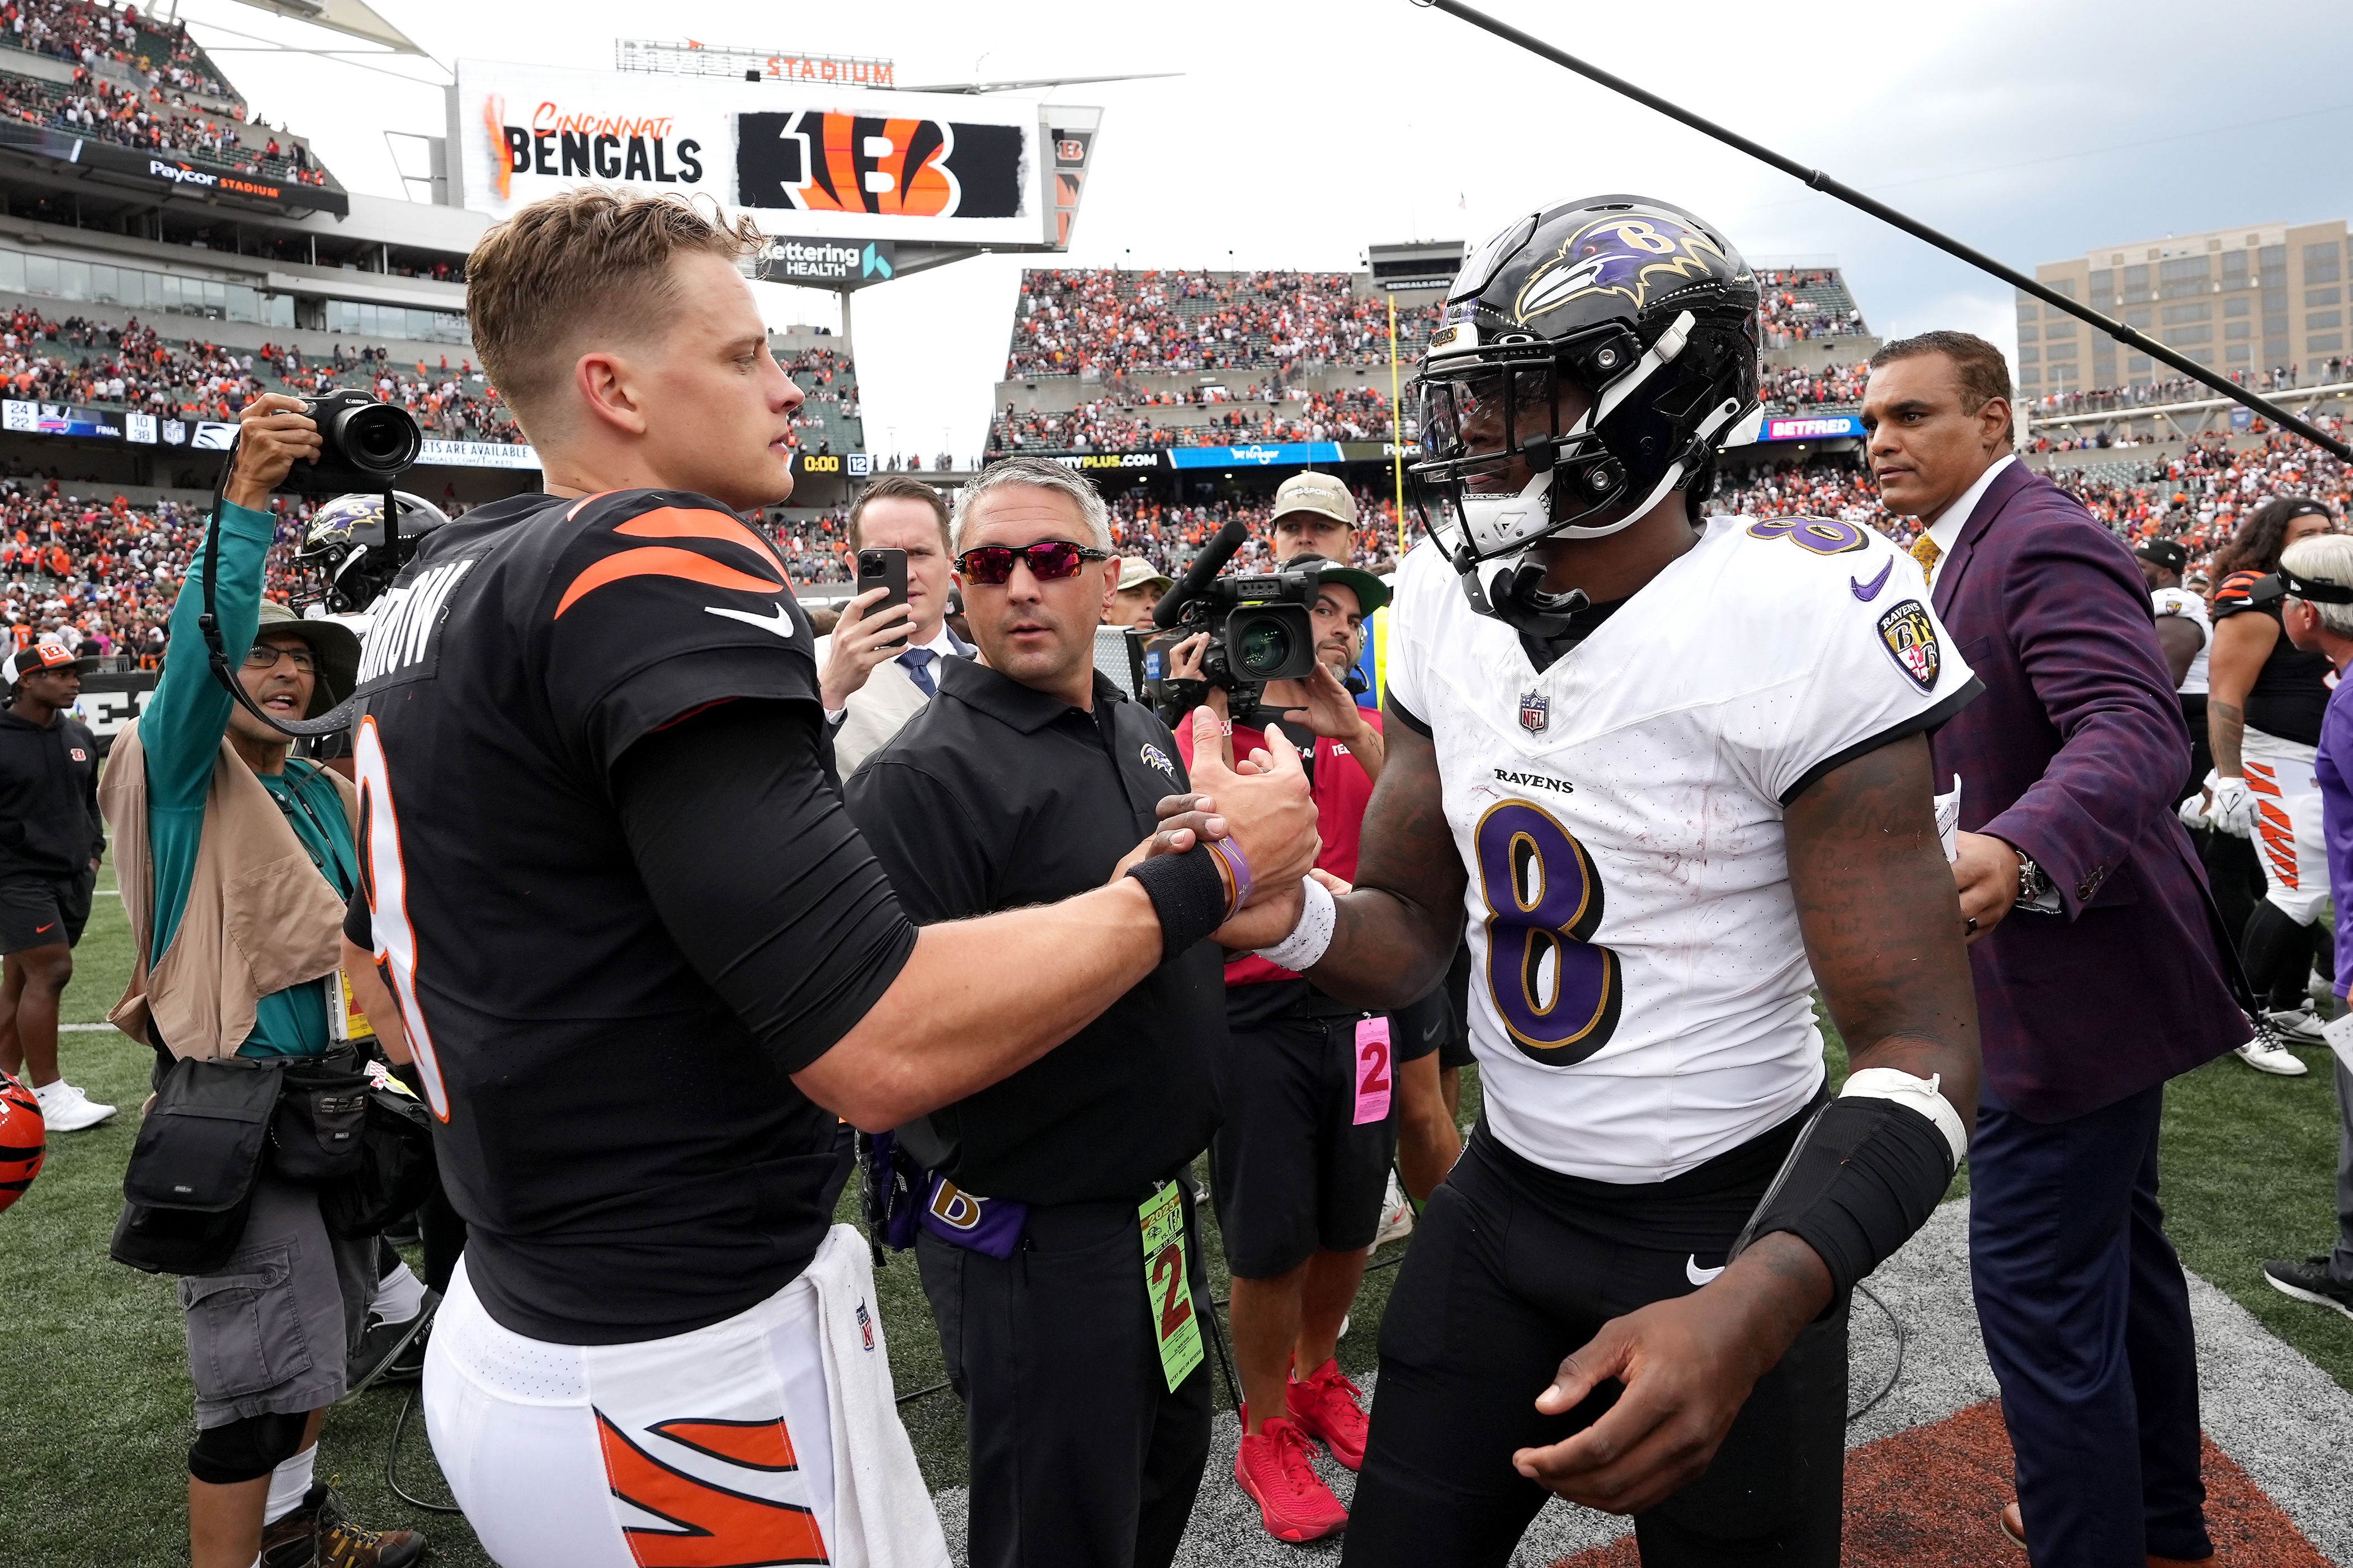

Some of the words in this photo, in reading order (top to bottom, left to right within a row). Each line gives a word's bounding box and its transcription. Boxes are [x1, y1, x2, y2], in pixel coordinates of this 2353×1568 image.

[767, 56, 893, 84] STADIUM
[504, 126, 703, 183] BENGALS
[150, 160, 218, 186] Paycor
[220, 178, 280, 197] STADIUM
[764, 241, 860, 267] ettering
[786, 262, 846, 277] HEALTH
[11, 403, 27, 414] 24
[12, 417, 30, 428] 22
[135, 415, 148, 427] 10
[1772, 417, 1851, 438] BETFRED
[96, 426, 121, 437] FINAL
[134, 429, 149, 440] 38
[446, 443, 466, 455] ARE
[471, 445, 528, 458] AVAILABLE
[804, 456, 839, 472] 0:00
[851, 457, 867, 472] 12
[1304, 487, 1335, 500] SPORTS
[1746, 516, 1869, 555] 8
[1880, 602, 1920, 630] RAVENS
[1522, 709, 1543, 729] NFL
[1494, 768, 1574, 794] RAVENS
[1474, 798, 1623, 1067] 8
[1360, 1042, 1389, 1095] 2
[1148, 1199, 1175, 1226] 2023
[1153, 1244, 1163, 1255] SEPT.
[1152, 1244, 1192, 1342] 2
[1169, 1372, 1178, 1385] ENTRY
